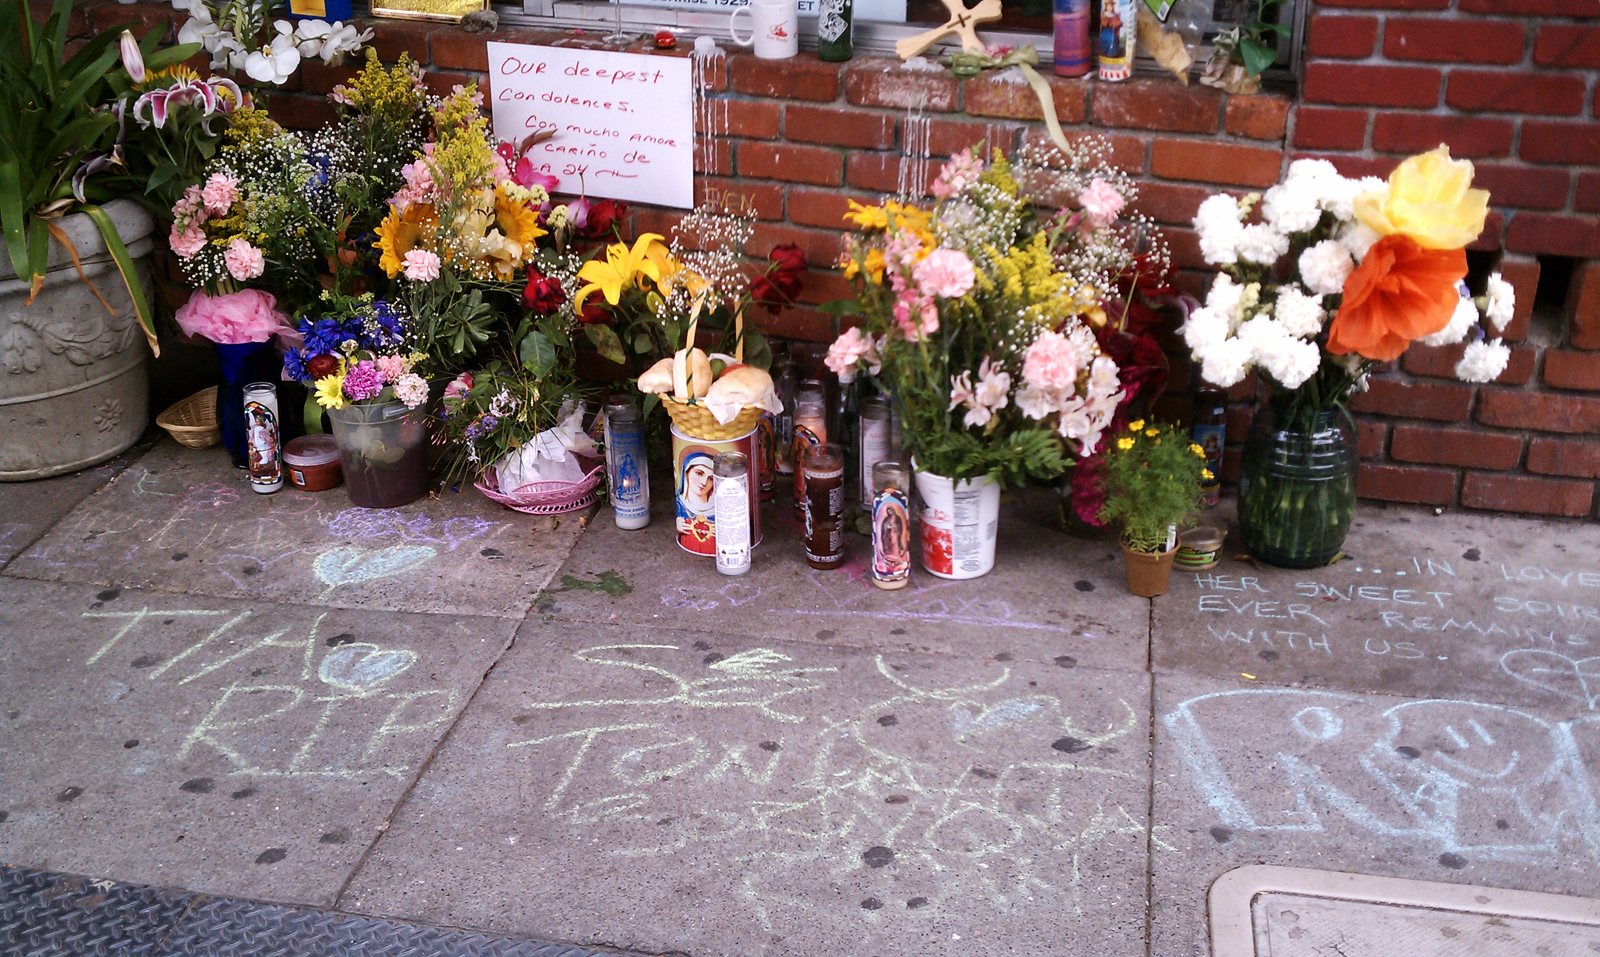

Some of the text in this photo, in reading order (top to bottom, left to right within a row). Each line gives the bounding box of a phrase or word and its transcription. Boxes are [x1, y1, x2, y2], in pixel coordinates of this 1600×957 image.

[501, 56, 664, 84] OUR deepest
[525, 115, 558, 129] Con
[566, 124, 620, 138] mucho
[623, 150, 651, 164] de
[1193, 572, 1270, 594] HER
[1294, 580, 1454, 609] SWEET
[1197, 593, 1590, 650] EVER REMAINS
[1206, 623, 1332, 655] WITH
[176, 680, 460, 775] RIP
